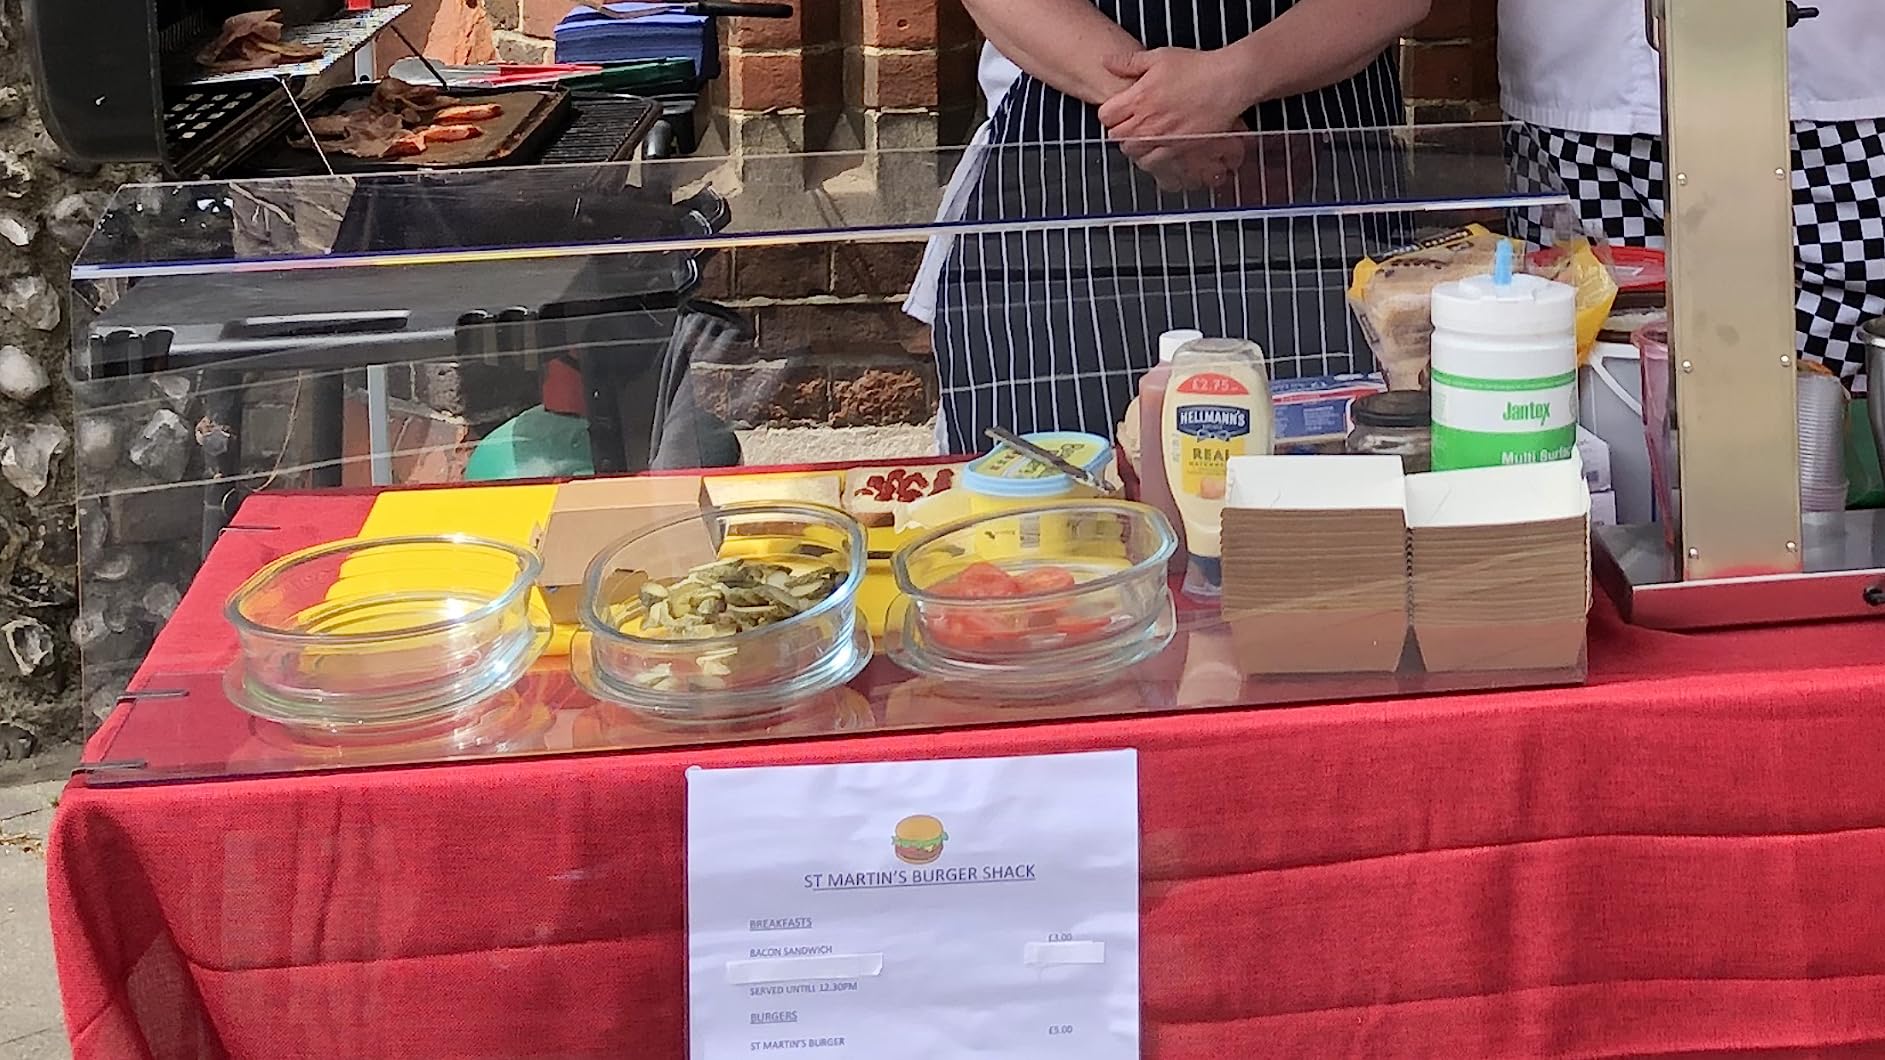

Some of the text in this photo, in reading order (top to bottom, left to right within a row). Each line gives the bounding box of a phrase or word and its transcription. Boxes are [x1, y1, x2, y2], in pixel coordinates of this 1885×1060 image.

[1192, 379, 1230, 391] £2.75
[1180, 408, 1246, 427] HELLMANN'S
[1503, 401, 1551, 426] Jantex
[1501, 450, 1537, 465] Multi
[804, 863, 1036, 889] ST MARTIN'S BURGER SHACK
[749, 917, 813, 932] BREAKFASTS
[749, 945, 833, 958] BACON SANDWICH
[750, 986, 784, 996] SERVED
[749, 1010, 798, 1025] BURGERS
[751, 1037, 845, 1051] ST MARTIN'S BURGER
